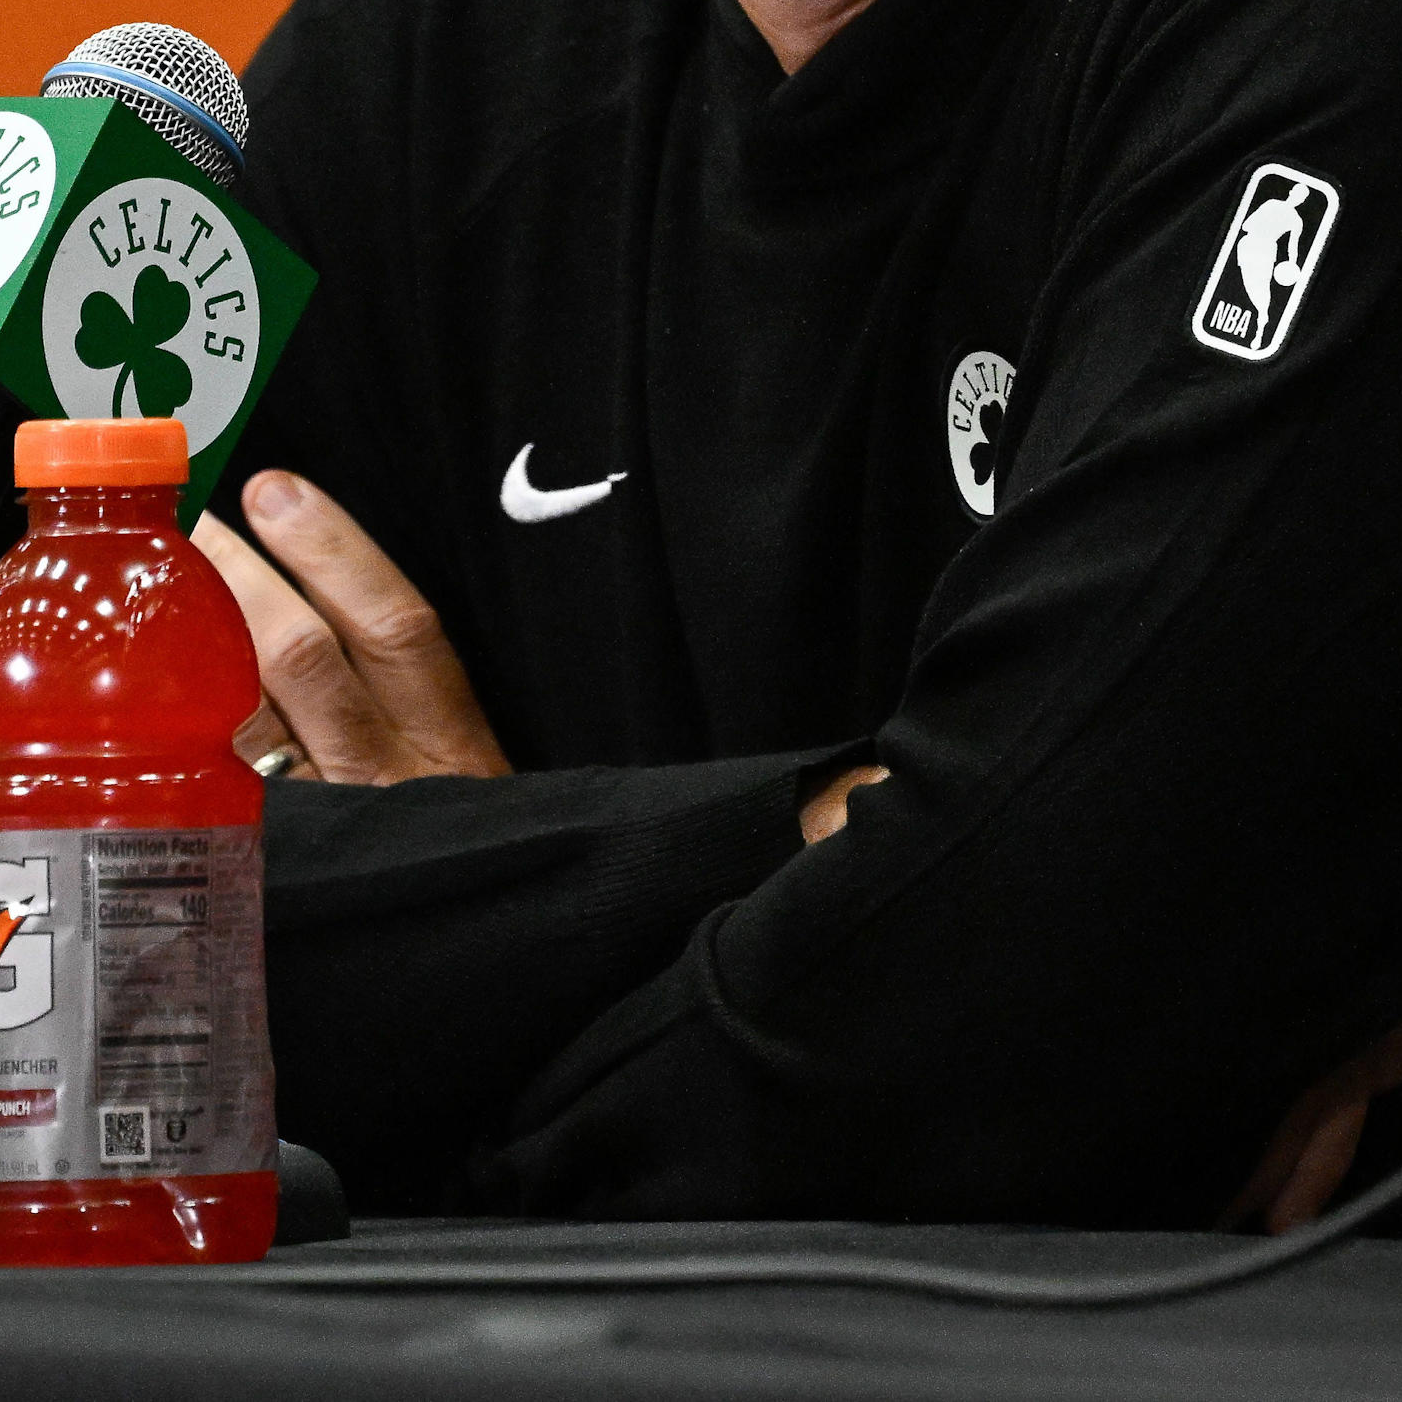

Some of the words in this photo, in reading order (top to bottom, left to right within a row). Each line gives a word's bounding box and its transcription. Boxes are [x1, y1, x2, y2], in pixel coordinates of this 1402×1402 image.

[88, 197, 247, 364] CELTICS
[1209, 300, 1252, 339] NBA
[953, 361, 1015, 433] CELTIC
[97, 837, 167, 856] Nutrition
[172, 836, 209, 855] Facts
